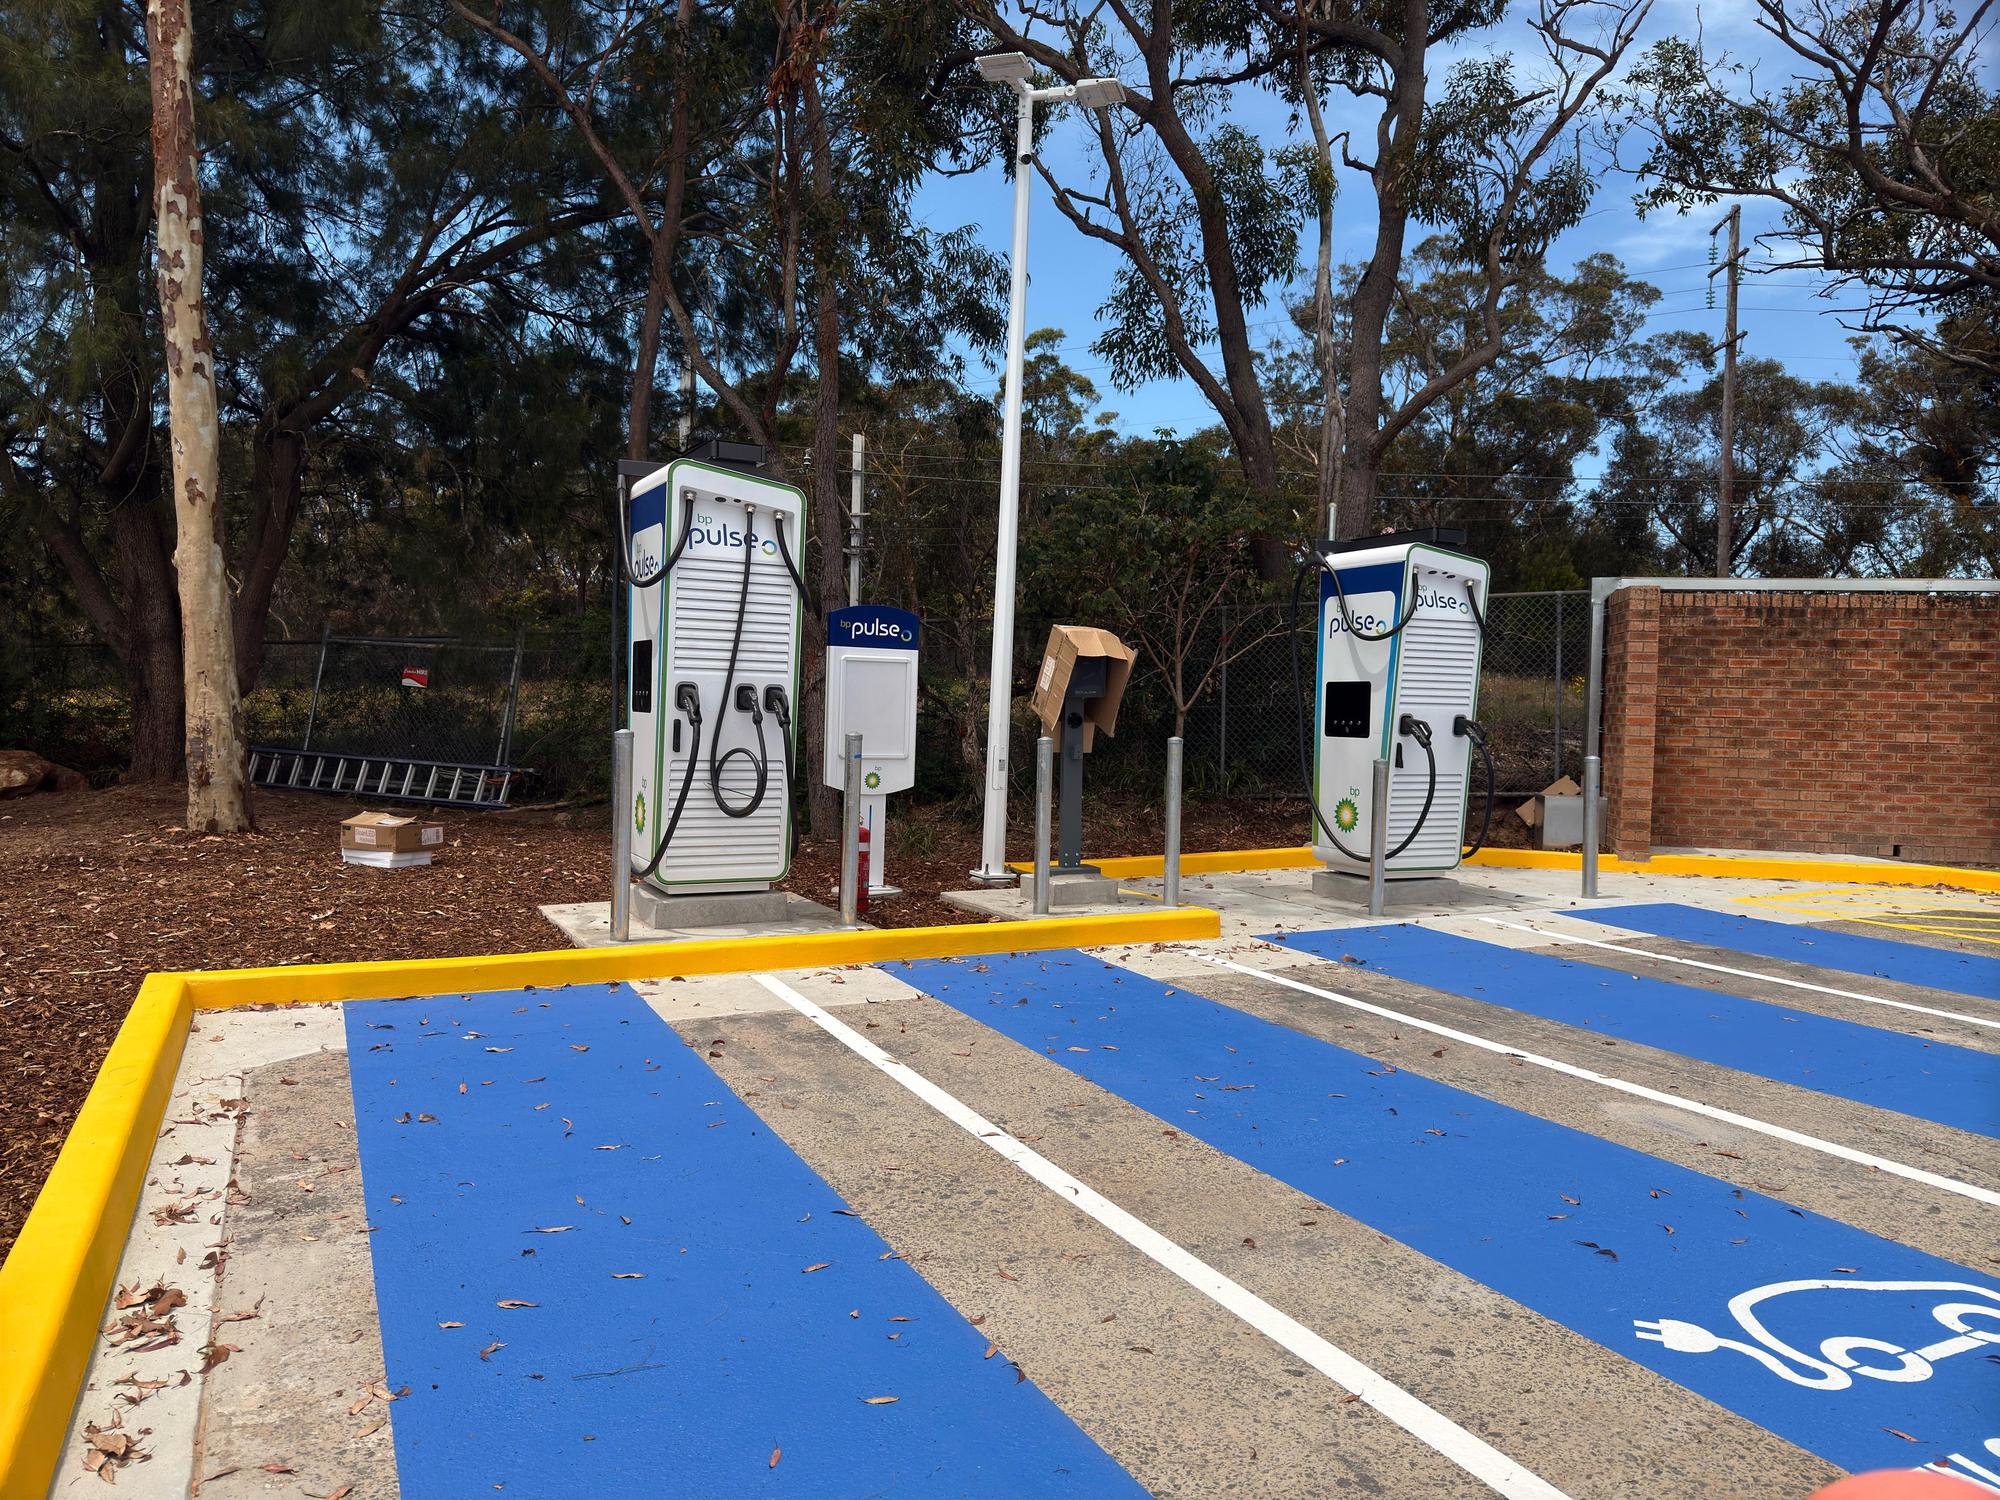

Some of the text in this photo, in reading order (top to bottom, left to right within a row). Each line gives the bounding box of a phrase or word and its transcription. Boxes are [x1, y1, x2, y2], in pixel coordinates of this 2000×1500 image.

[697, 513, 713, 526] bp
[688, 523, 759, 550] pulse
[1415, 590, 1457, 612] pulse
[840, 617, 900, 639] bp pulse
[1329, 609, 1375, 639] pulse
[1349, 785, 1360, 799] bp
